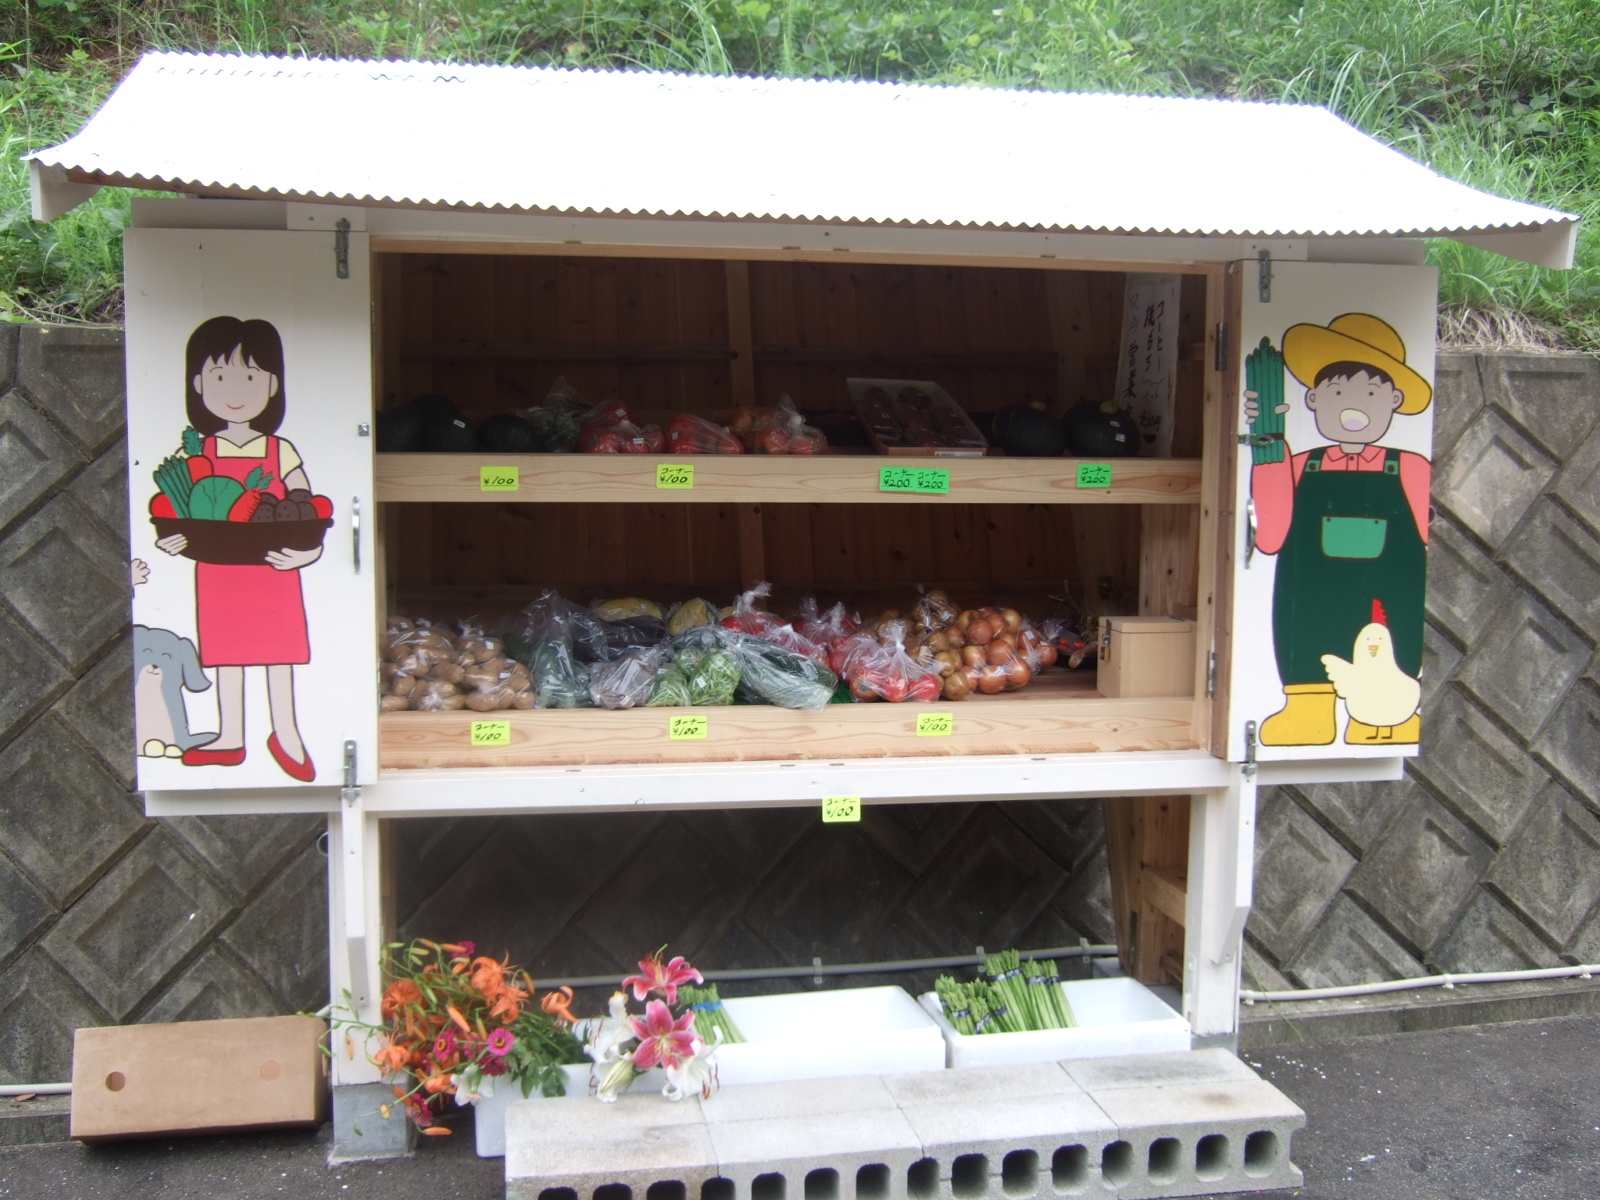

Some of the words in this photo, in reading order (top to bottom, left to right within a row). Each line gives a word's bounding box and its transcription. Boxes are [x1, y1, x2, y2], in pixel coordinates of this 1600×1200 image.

[661, 467, 693, 475] コーナー
[884, 468, 915, 478] コーナー
[917, 470, 946, 480] コーナー
[483, 476, 515, 485] ¥100
[660, 474, 688, 483] ¥100
[883, 478, 910, 488] ¥200
[1081, 476, 1106, 484] ¥200
[917, 480, 943, 489] ¥200
[672, 727, 699, 736] ¥100
[474, 733, 502, 741] ¥100
[825, 806, 854, 818] ¥100
